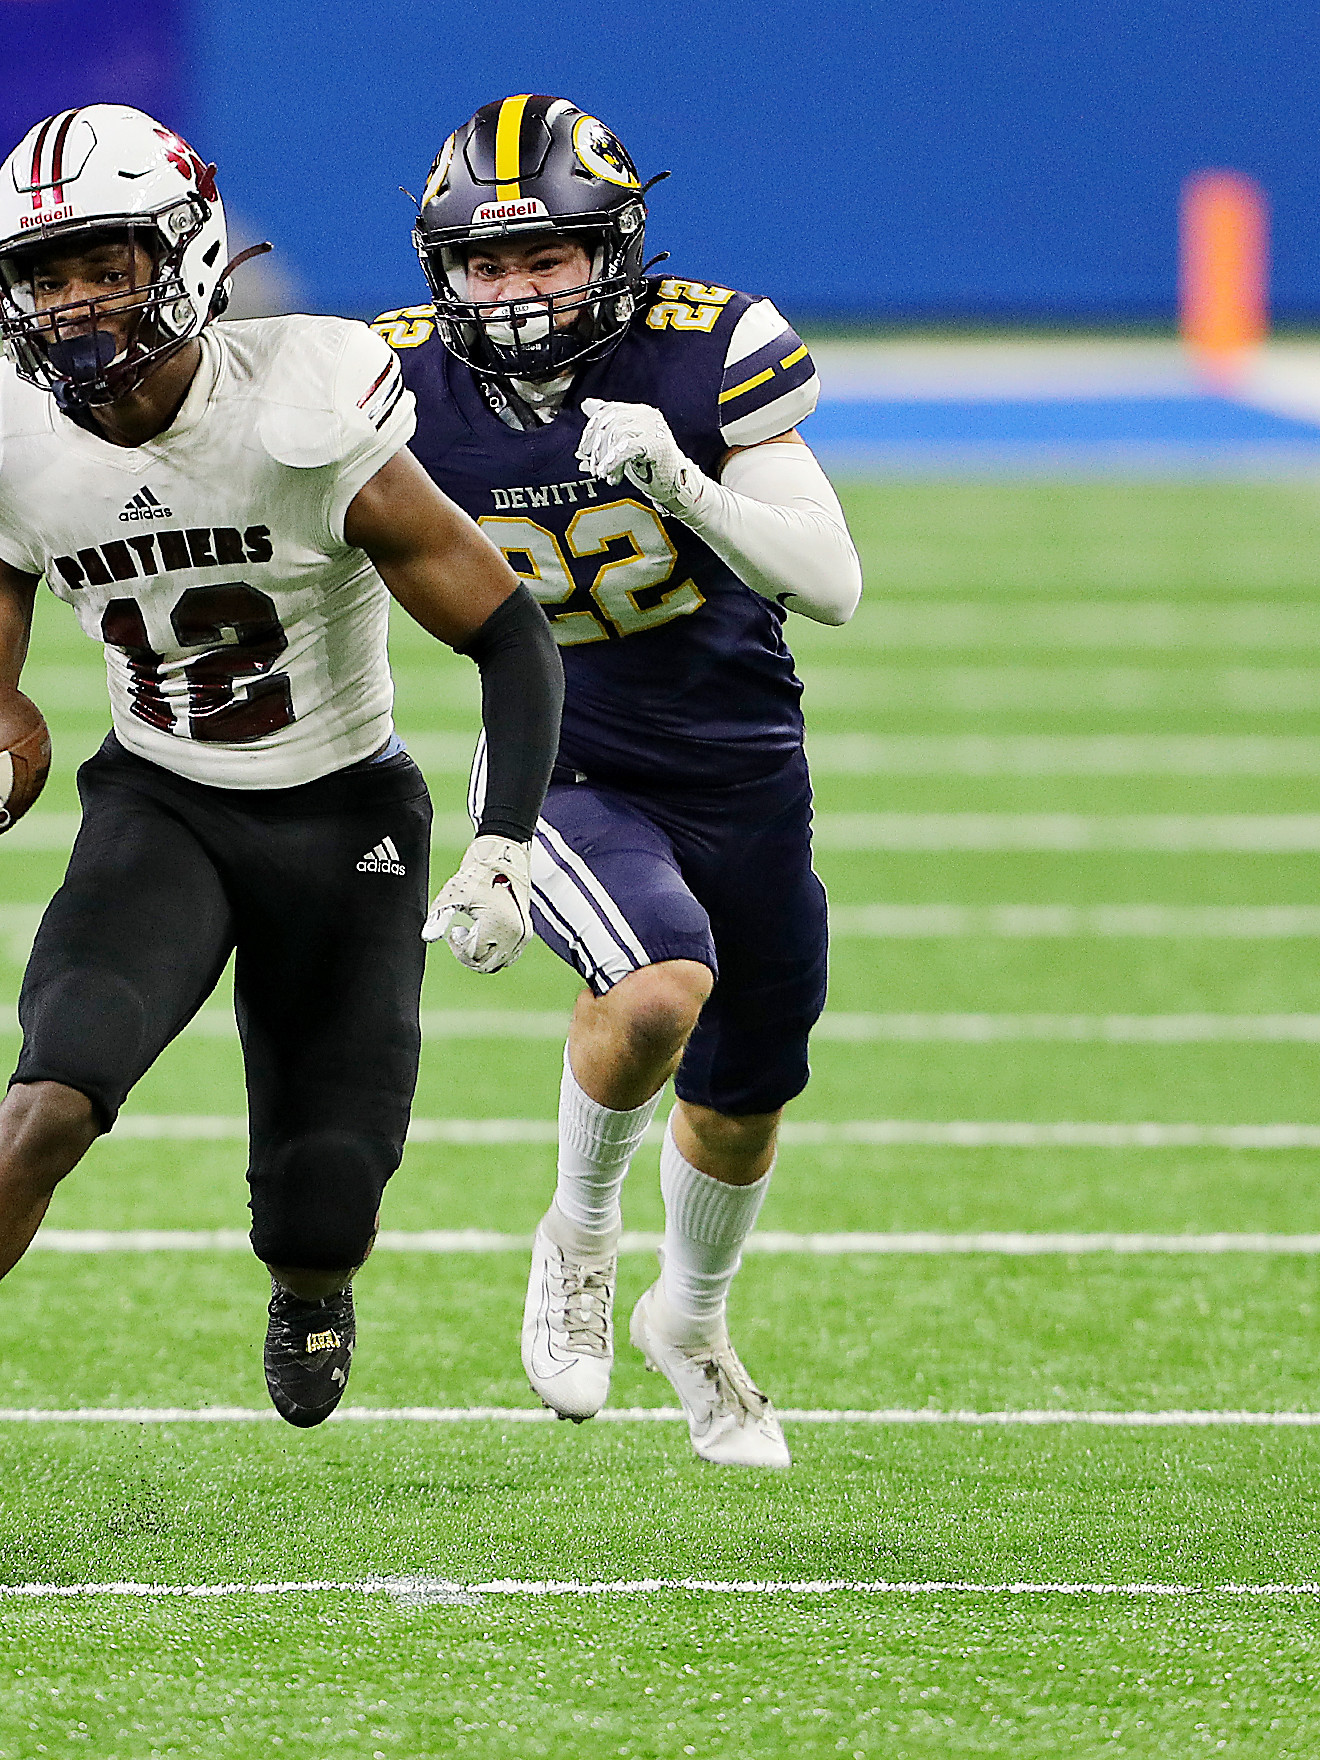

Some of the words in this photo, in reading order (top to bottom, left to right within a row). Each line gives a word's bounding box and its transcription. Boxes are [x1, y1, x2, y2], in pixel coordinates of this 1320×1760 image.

[19, 205, 73, 229] Riddell
[480, 201, 538, 220] Riddell
[645, 279, 737, 333] 22
[490, 478, 598, 511] DEWITT
[118, 504, 173, 523] adidas
[53, 524, 275, 591] PANTHERS
[477, 497, 707, 647] 22
[100, 581, 297, 743] 12
[356, 858, 406, 876] adidas
